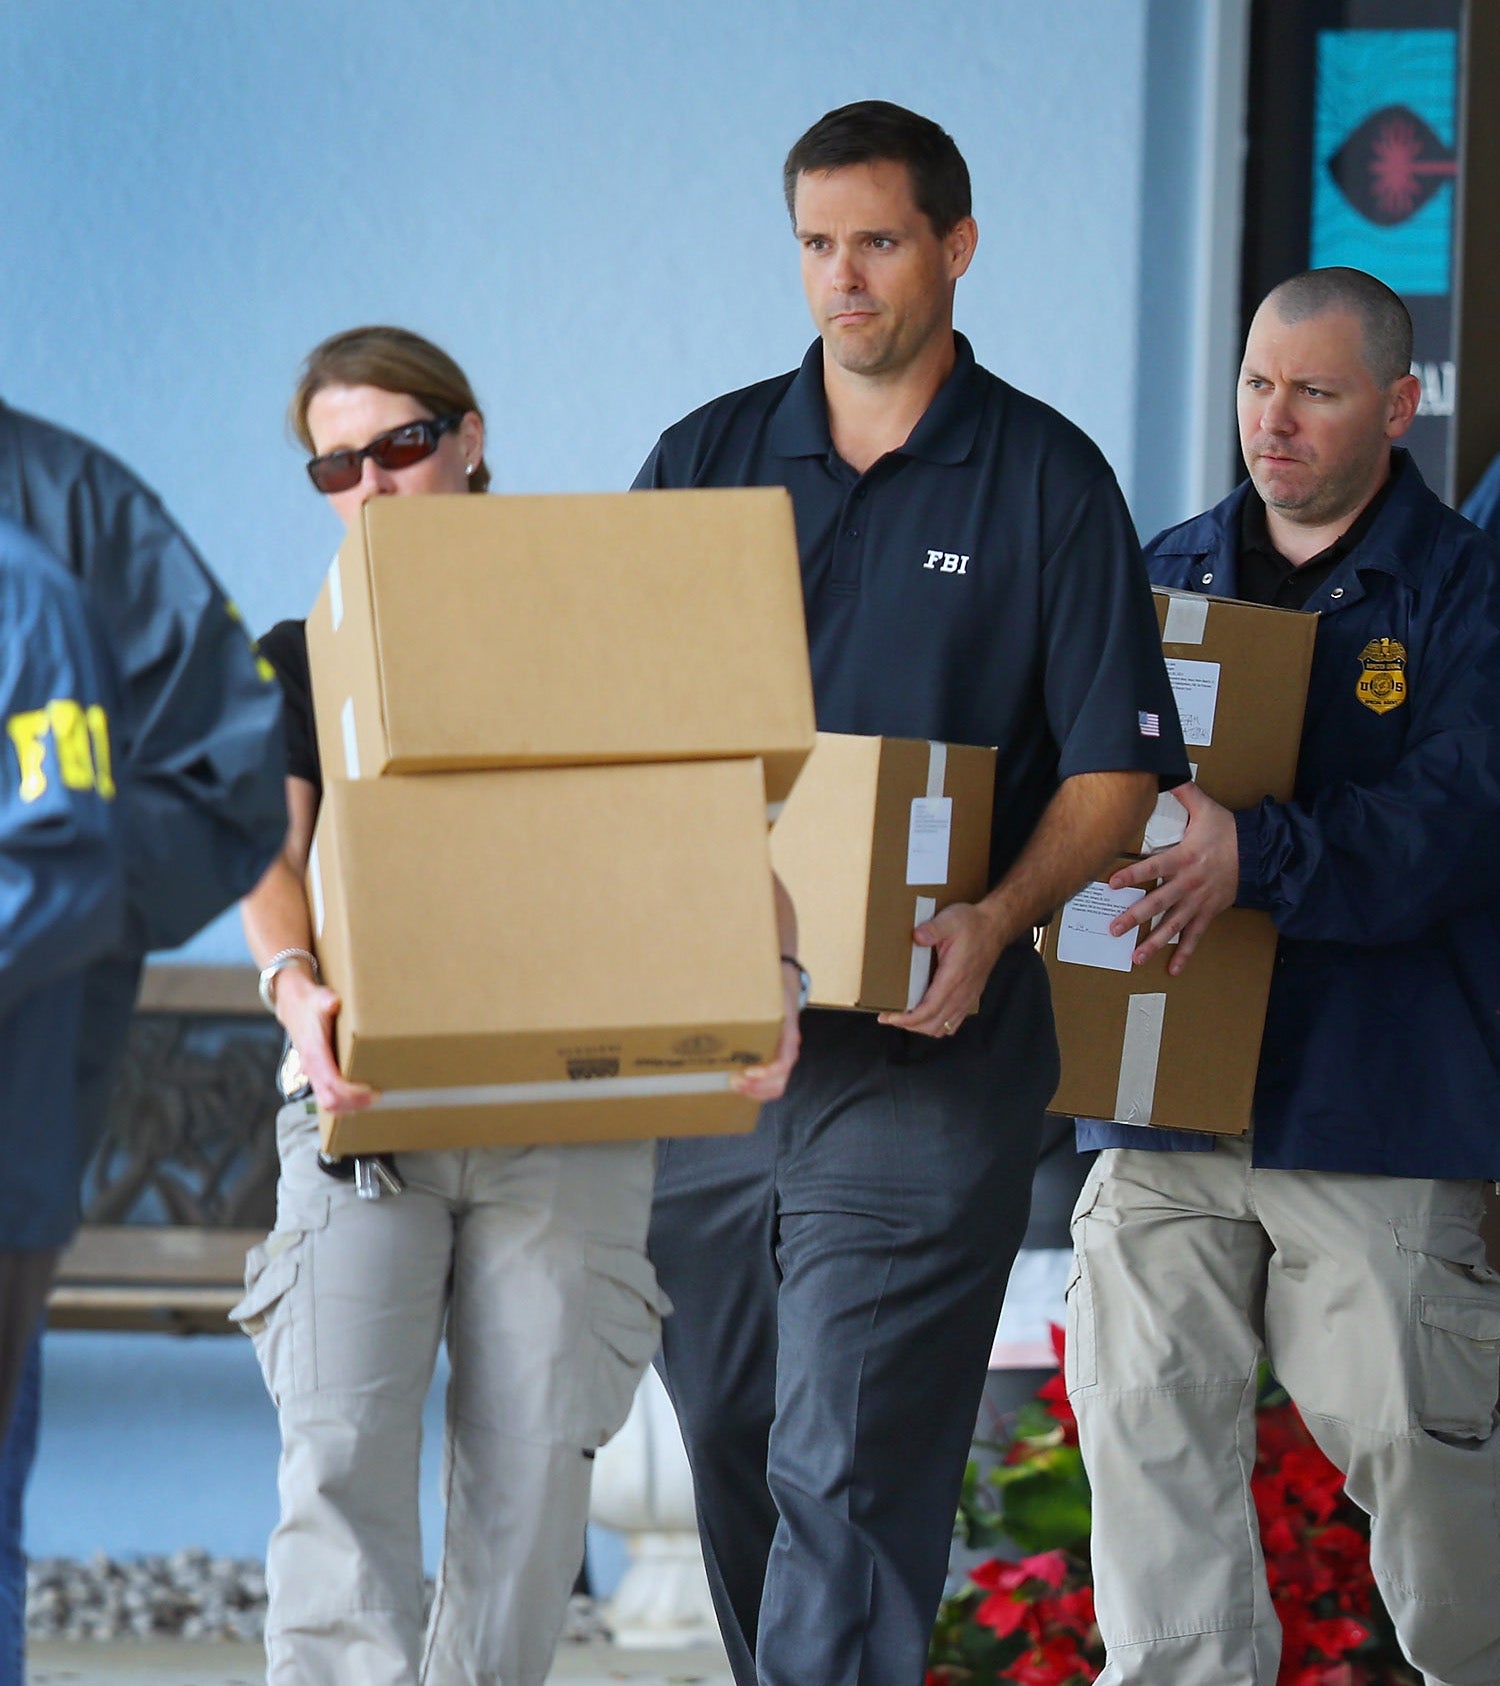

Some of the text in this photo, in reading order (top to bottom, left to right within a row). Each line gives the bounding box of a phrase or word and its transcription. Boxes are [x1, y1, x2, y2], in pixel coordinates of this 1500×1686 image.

[923, 549, 970, 575] FBI
[1360, 681, 1404, 692] U S
[6, 698, 117, 804] FBI
